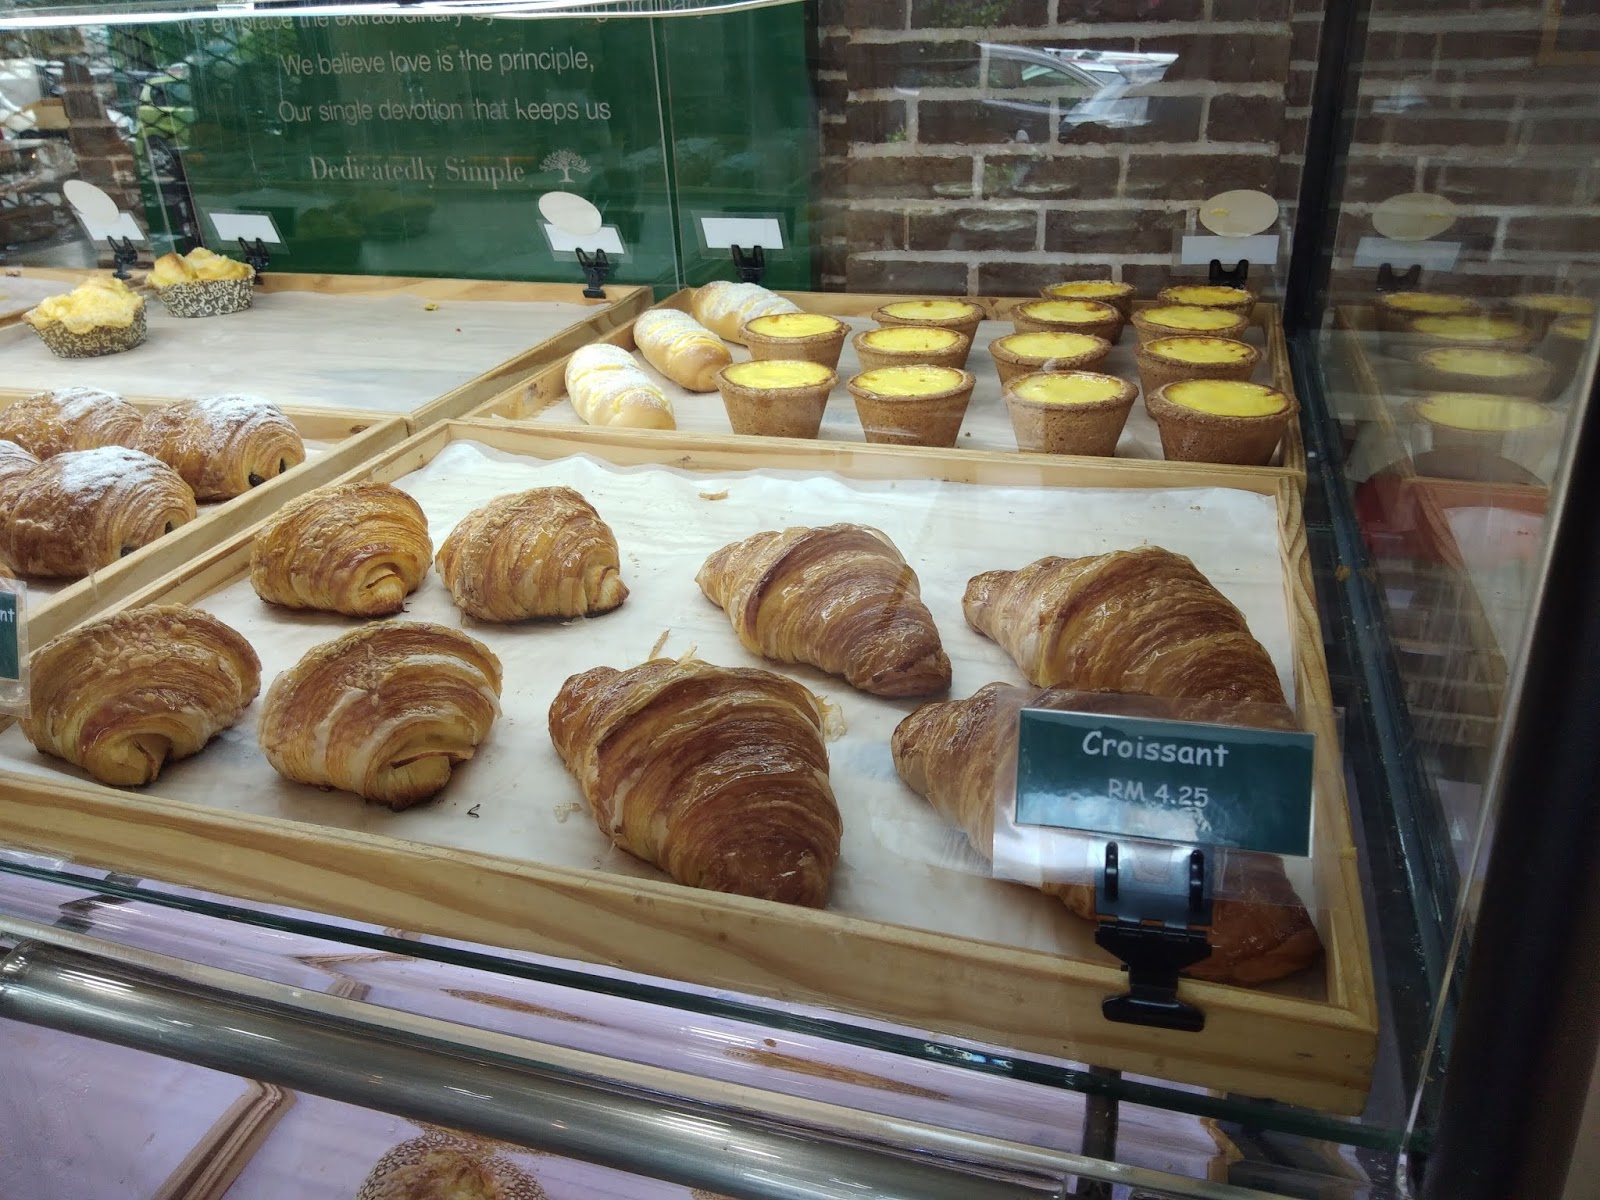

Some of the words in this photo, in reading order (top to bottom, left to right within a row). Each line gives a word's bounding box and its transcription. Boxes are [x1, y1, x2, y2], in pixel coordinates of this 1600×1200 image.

[280, 54, 314, 76] We
[317, 52, 385, 75] believe
[390, 51, 432, 73] love
[437, 50, 454, 72] is
[459, 49, 492, 71] the
[499, 46, 595, 76] principle,
[279, 101, 312, 123] Our
[319, 100, 373, 126] single
[379, 99, 463, 121] devotion
[472, 99, 508, 120] that
[515, 97, 579, 125] keeps
[585, 103, 612, 120] us
[310, 156, 438, 187] Dedicatedly
[445, 156, 525, 190] Simple
[1082, 731, 1229, 767] Croissant
[1108, 778, 1146, 802] RM
[1154, 783, 1209, 808] 4.25
